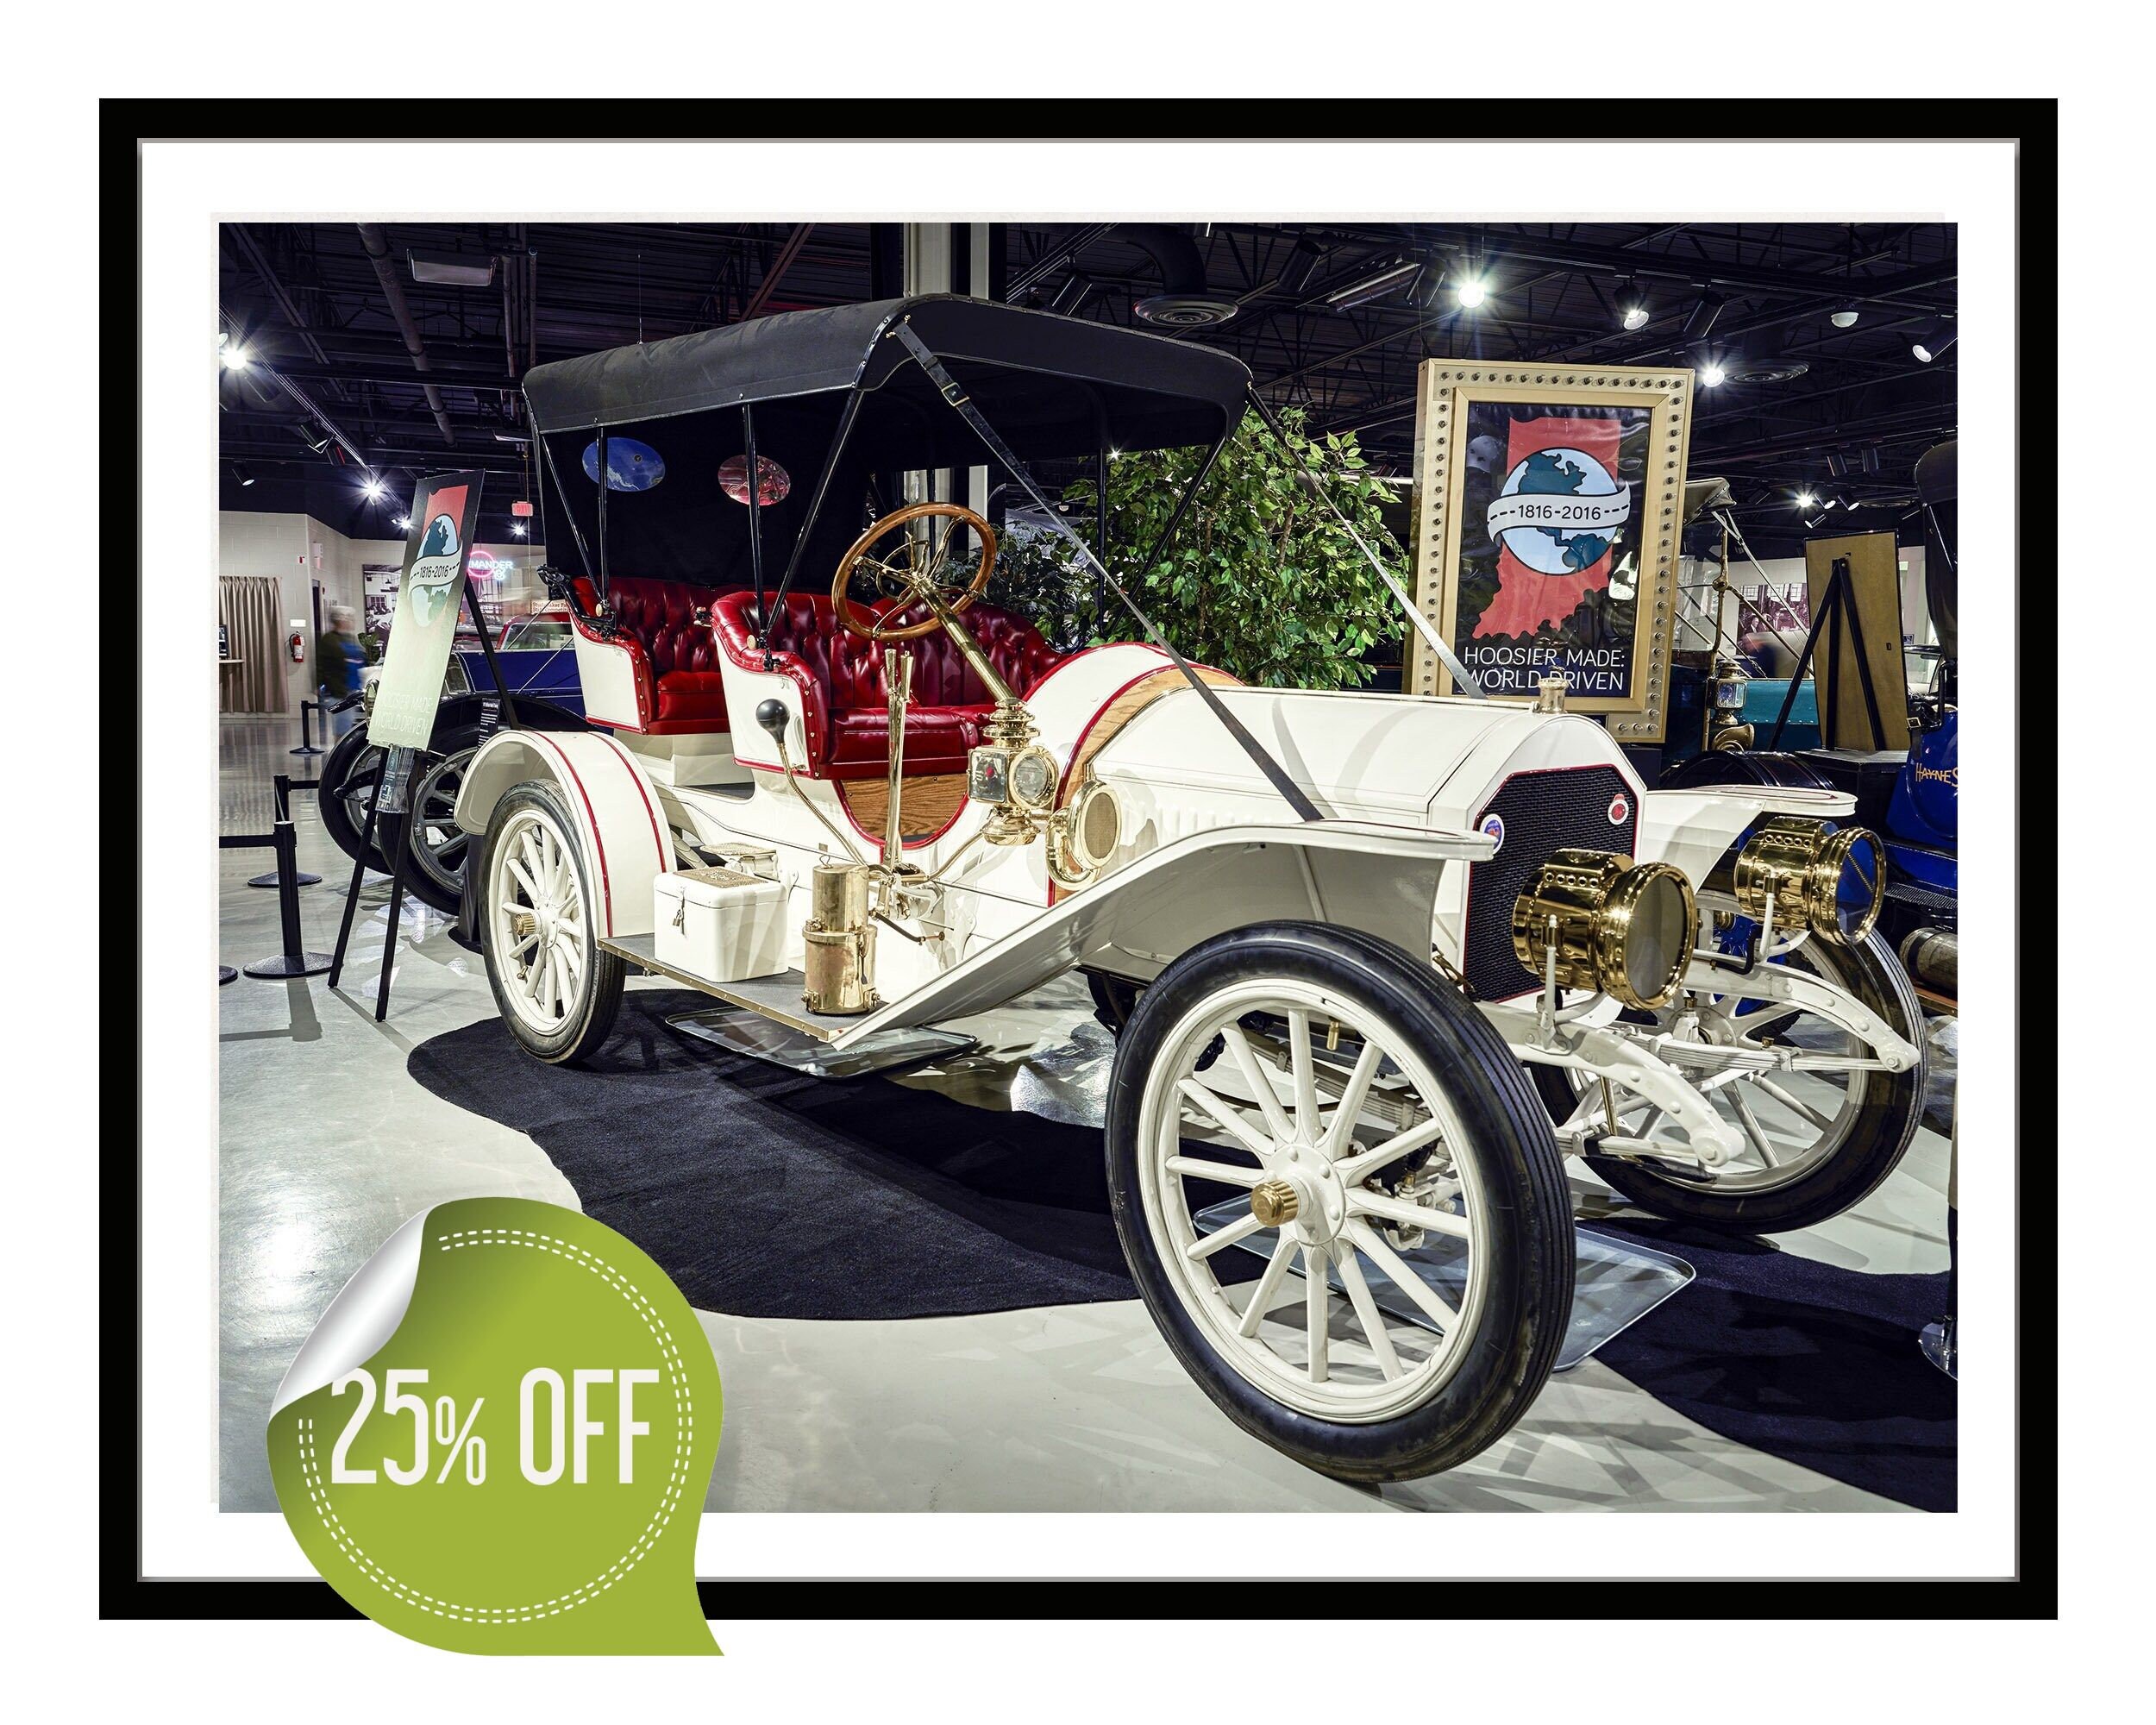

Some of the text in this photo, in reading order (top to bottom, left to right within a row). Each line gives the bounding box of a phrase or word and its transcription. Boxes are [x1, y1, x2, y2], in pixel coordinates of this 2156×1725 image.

[1518, 505, 1601, 520] 1816-2016
[468, 560, 513, 570] MANDER
[1465, 647, 1626, 668] HOOSIER MADE:
[1915, 762, 1958, 787] HAYNES
